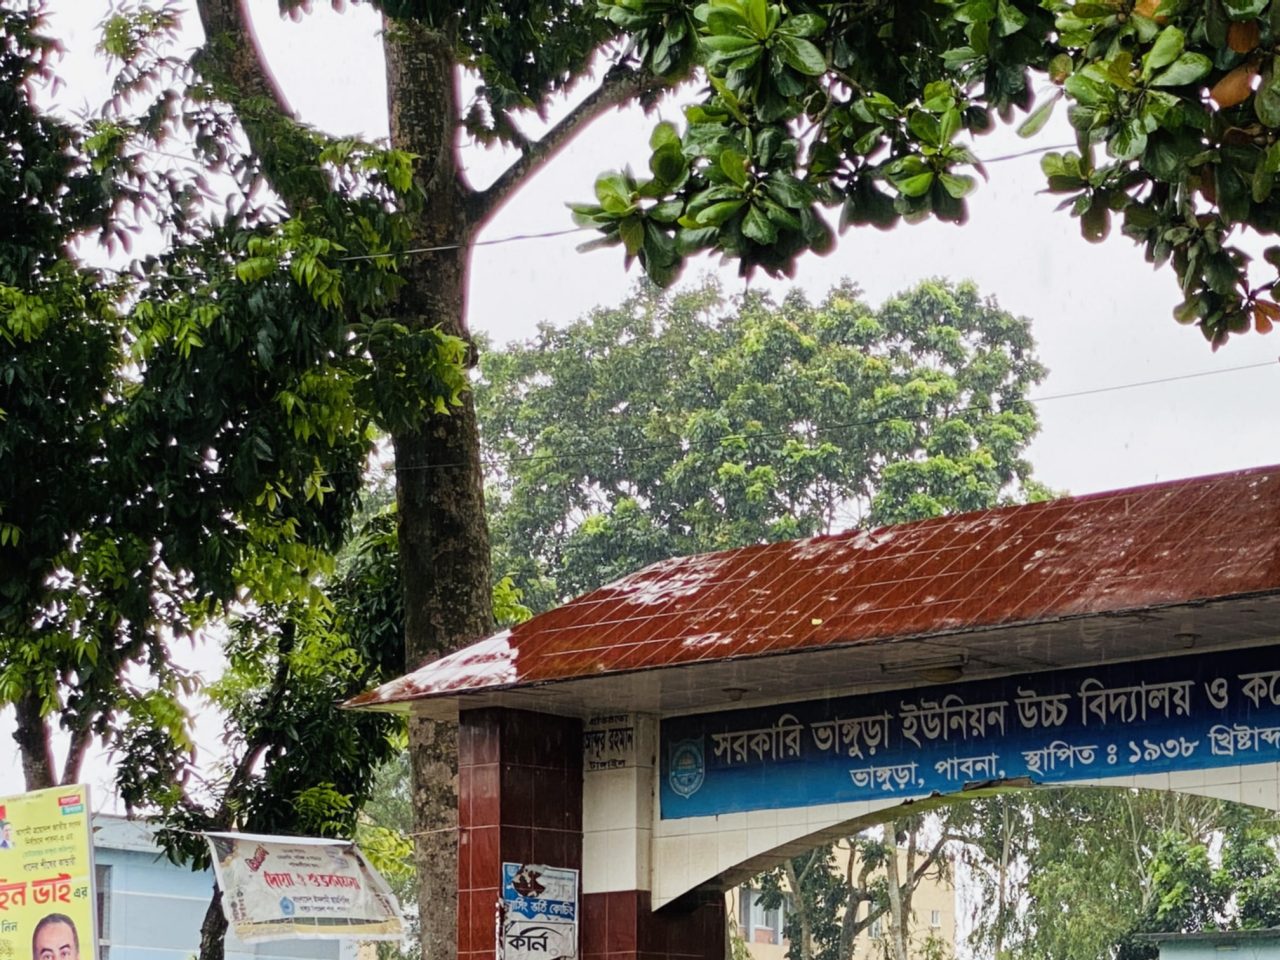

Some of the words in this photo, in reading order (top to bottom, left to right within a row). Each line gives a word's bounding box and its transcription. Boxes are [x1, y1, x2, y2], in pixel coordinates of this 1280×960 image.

[712, 714, 804, 765] সরকারি
[811, 710, 894, 760] ভাঙ্গুড়া
[900, 694, 1009, 748] ইউনিয়ন
[1015, 686, 1072, 729] উচ্চ
[1077, 678, 1195, 727] বিদ্যালয়
[1204, 677, 1229, 710] ও
[850, 762, 924, 791] ভাঙ্গুড়া,
[934, 752, 1005, 780] পাবনা,
[1021, 740, 1098, 777] স্থাপিত
[1128, 737, 1200, 764] ১৯৩৮
[32, 873, 72, 904] ভাই
[74, 886, 88, 899] এর
